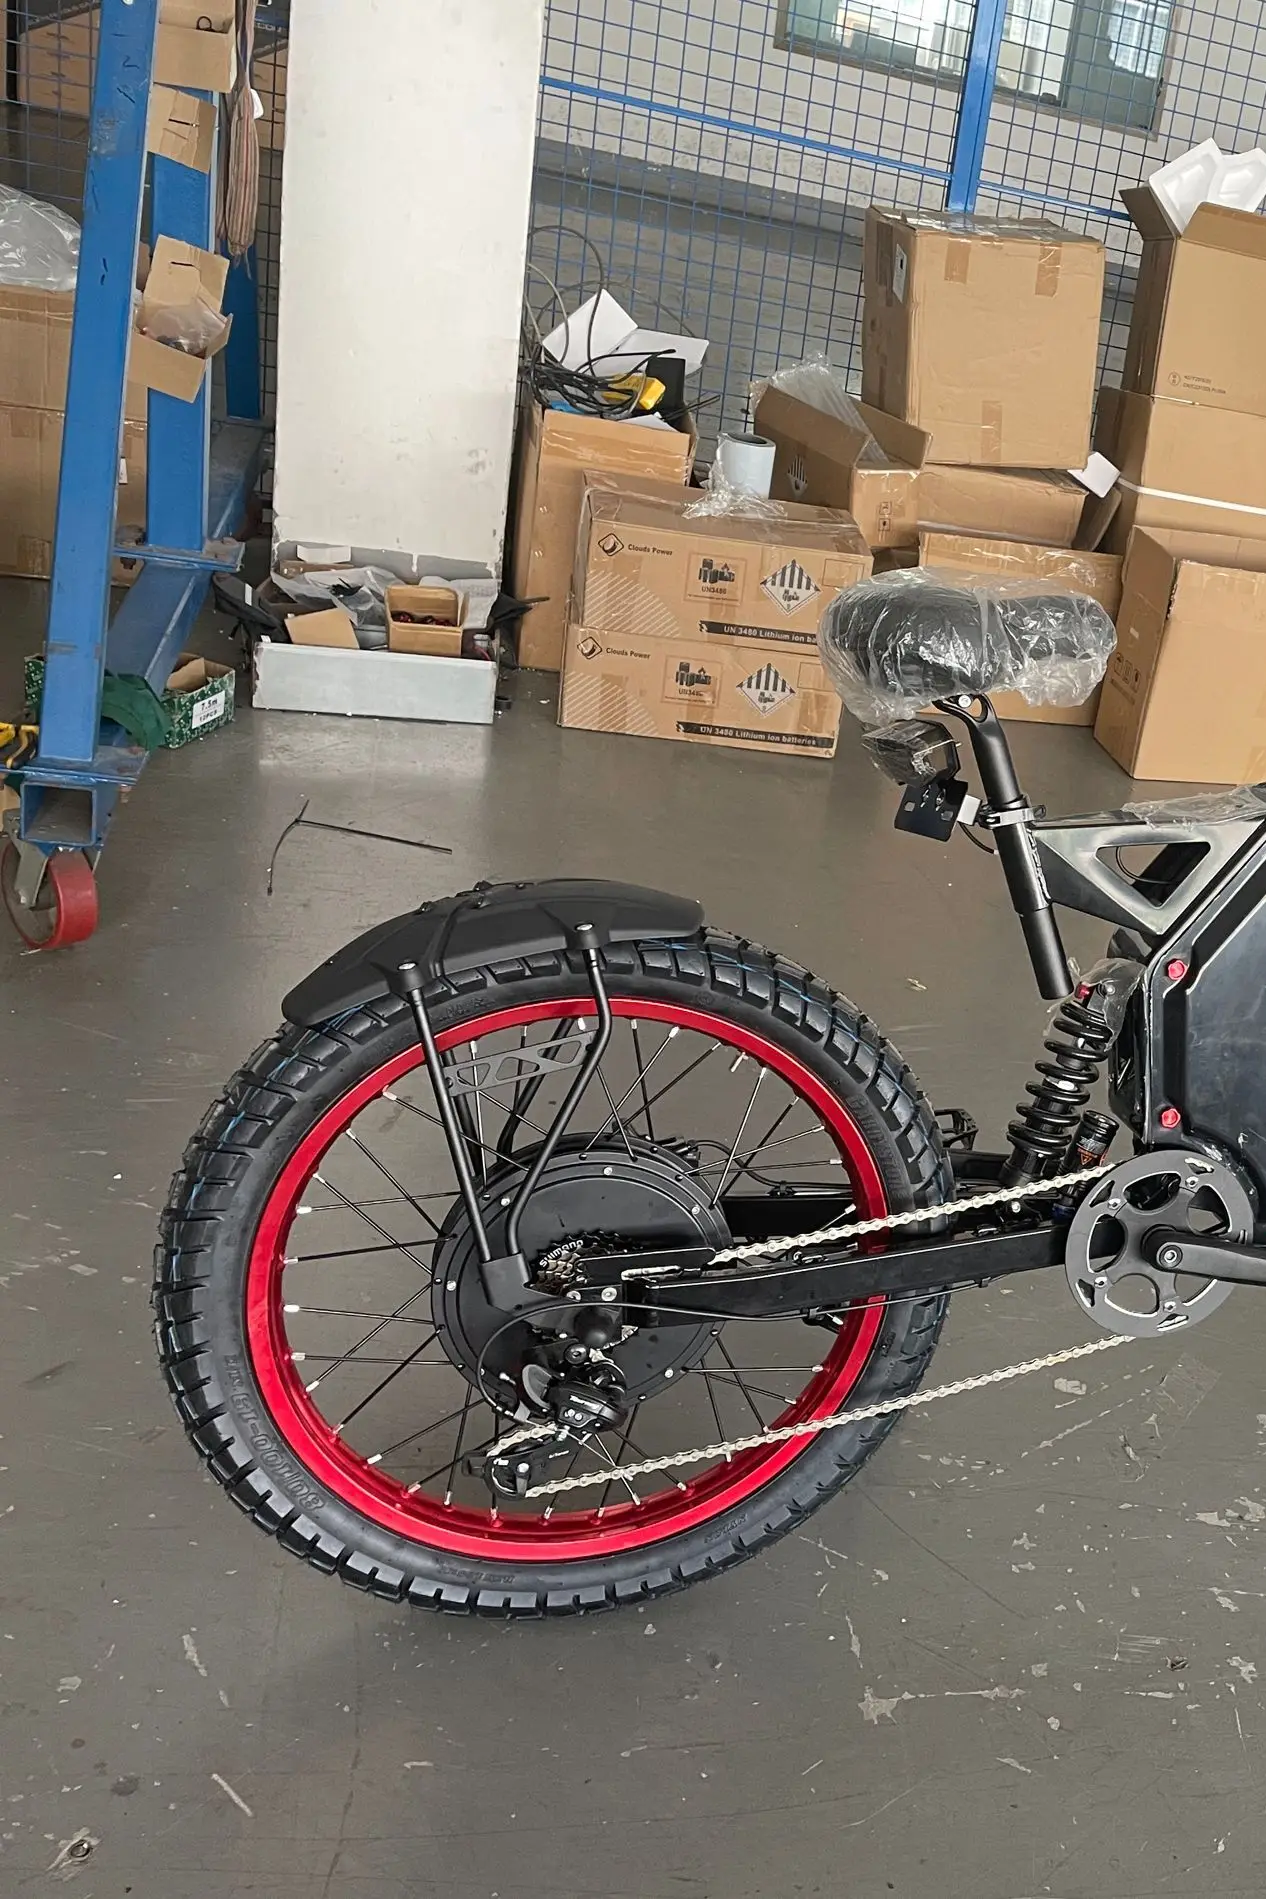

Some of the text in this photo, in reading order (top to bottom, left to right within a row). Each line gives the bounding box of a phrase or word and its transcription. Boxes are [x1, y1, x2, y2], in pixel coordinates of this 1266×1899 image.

[627, 543, 673, 556] Clouds Power
[701, 585, 727, 595] UN3480
[723, 625, 736, 633] UN
[738, 627, 757, 636] 3480
[759, 630, 790, 640] Lithium
[792, 634, 805, 642] ion
[606, 647, 651, 660] Clouds Power
[715, 728, 733, 737] 3480
[735, 730, 766, 741] Lithium
[782, 735, 816, 745] batteries
